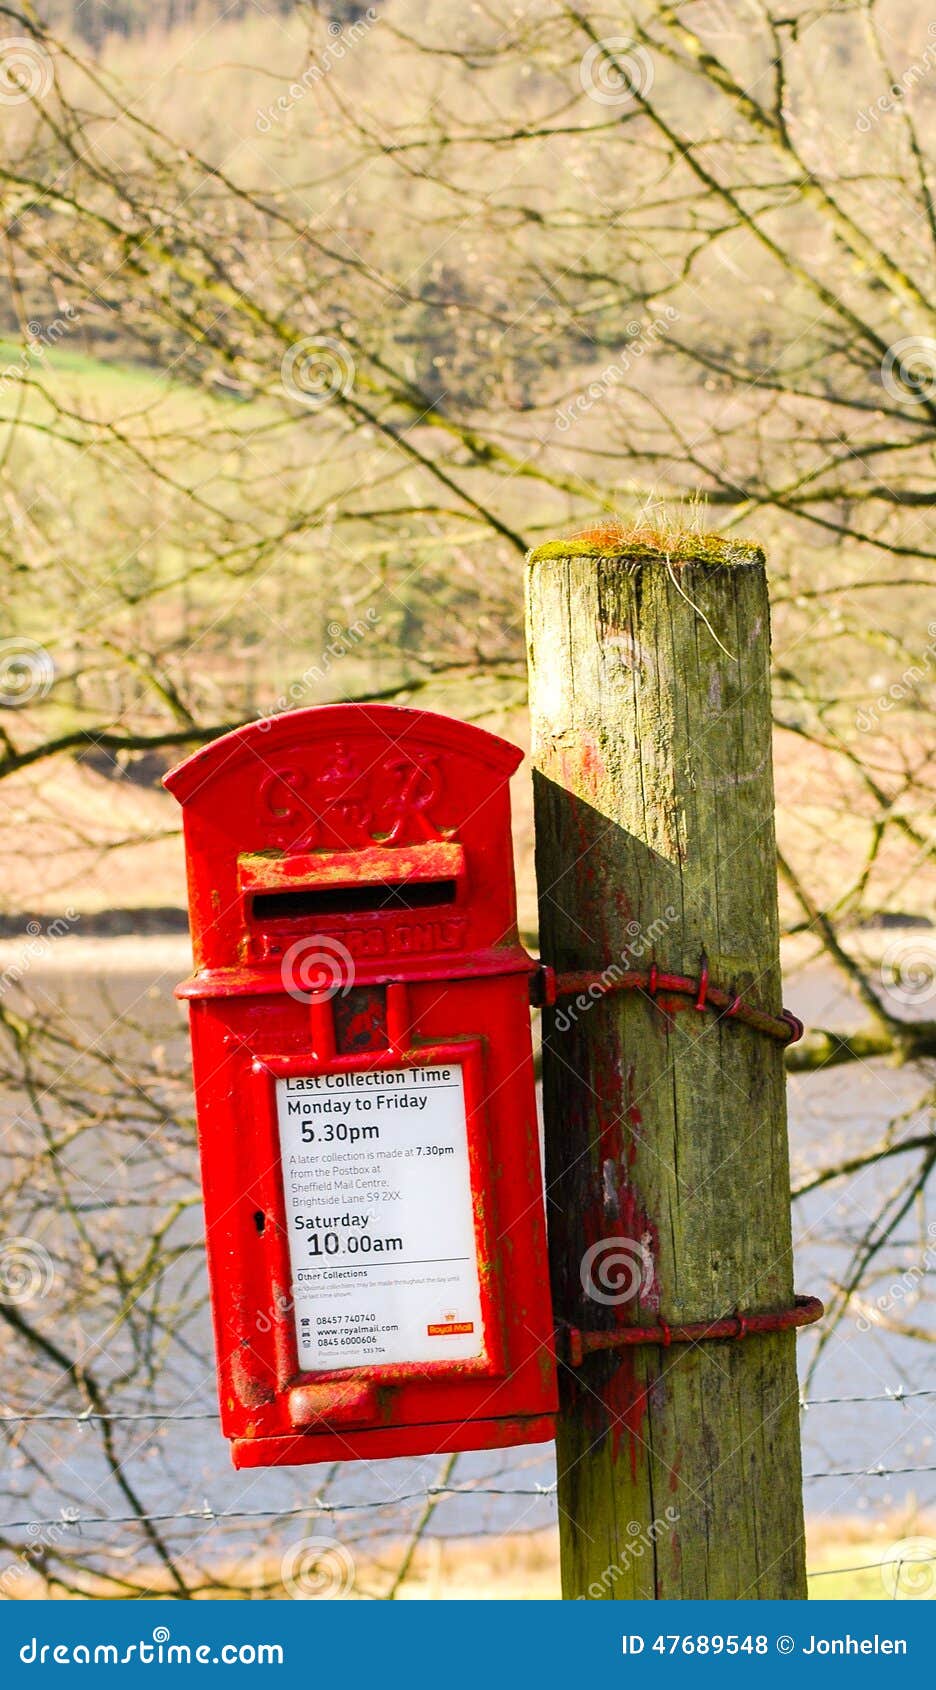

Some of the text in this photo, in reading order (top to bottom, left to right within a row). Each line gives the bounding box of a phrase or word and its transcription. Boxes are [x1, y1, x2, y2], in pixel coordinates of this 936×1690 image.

[286, 1067, 451, 1091] Last Collection Time
[287, 1094, 428, 1115] Monday to Friday
[301, 1120, 380, 1144] 5.30pm
[289, 1145, 455, 1164] A later collection is made at 7.30pm
[290, 1164, 382, 1179] from the Postbox at
[291, 1181, 332, 1193] Sheffield
[334, 1180, 354, 1190] Mail
[292, 1195, 339, 1208] Brightside
[341, 1193, 365, 1204] Lane
[367, 1191, 380, 1202] S9
[294, 1213, 369, 1230] Saturday
[307, 1232, 403, 1256] 10.00am
[296, 1270, 369, 1281] Other Collections
[316, 1313, 376, 1325] 08457 740740
[317, 1325, 399, 1336] www.royalmail.com
[317, 1335, 377, 1347] 0845 6000606
